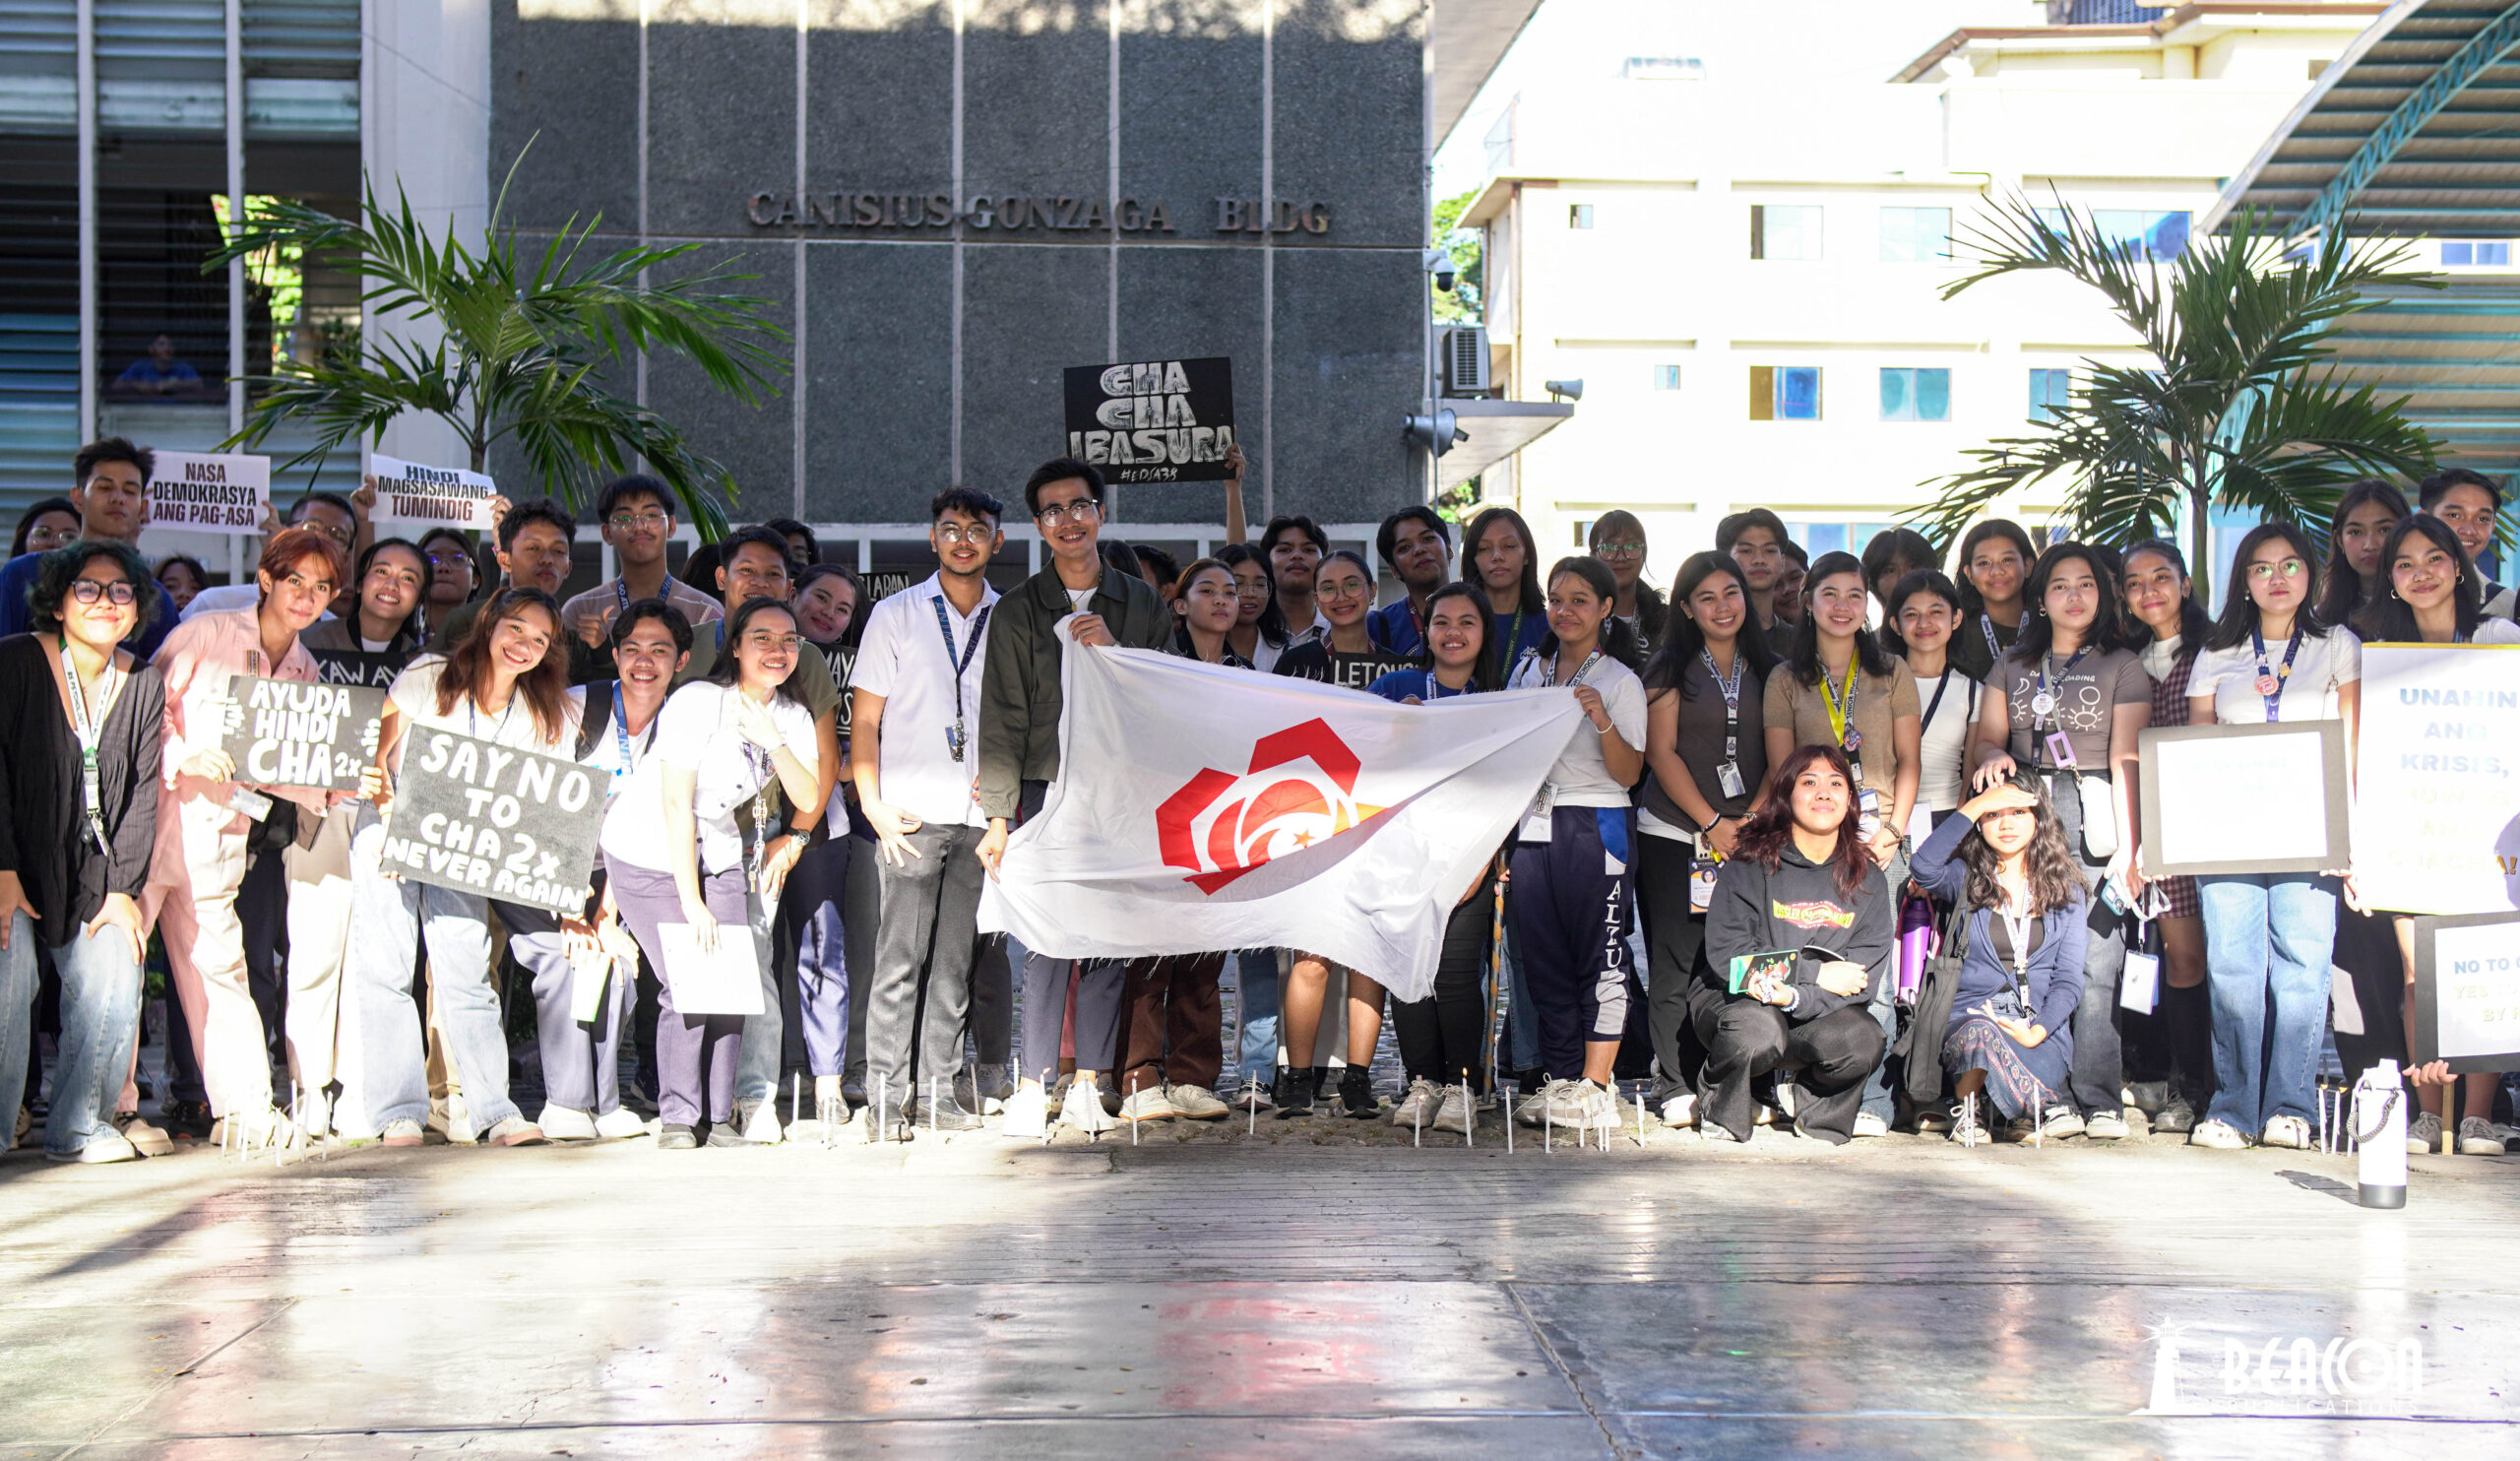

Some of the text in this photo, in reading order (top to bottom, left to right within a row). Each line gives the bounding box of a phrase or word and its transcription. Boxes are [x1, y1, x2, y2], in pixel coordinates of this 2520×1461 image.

[1100, 361, 1191, 397] CHA
[1096, 394, 1196, 429] CHA
[1070, 425, 1233, 466] IBASURA
[185, 462, 226, 482] NASA
[406, 465, 460, 483] HINDI
[154, 480, 256, 506] DEMOKRASYA
[378, 476, 488, 499] MAGSASAWANG
[154, 502, 255, 526] ANG PAG-ASA
[392, 495, 472, 521] TUMINDIG
[1335, 659, 1375, 685] LET
[1576, 656, 1597, 679] SCHOOL
[249, 680, 351, 718] AYUDA
[2399, 687, 2518, 709] UNAHIN
[254, 709, 339, 744] HINDI
[2424, 722, 2488, 740] ANG
[247, 737, 333, 786] CHA
[419, 733, 591, 812] SAY NO
[2400, 752, 2510, 779] KRISIS,
[465, 788, 521, 828] TO
[419, 812, 501, 859] CHA
[382, 837, 586, 912] NEVER AGAIN
[1605, 879, 1622, 969] ALZU
[2454, 959, 2481, 975] NO
[2486, 957, 2510, 972] TO
